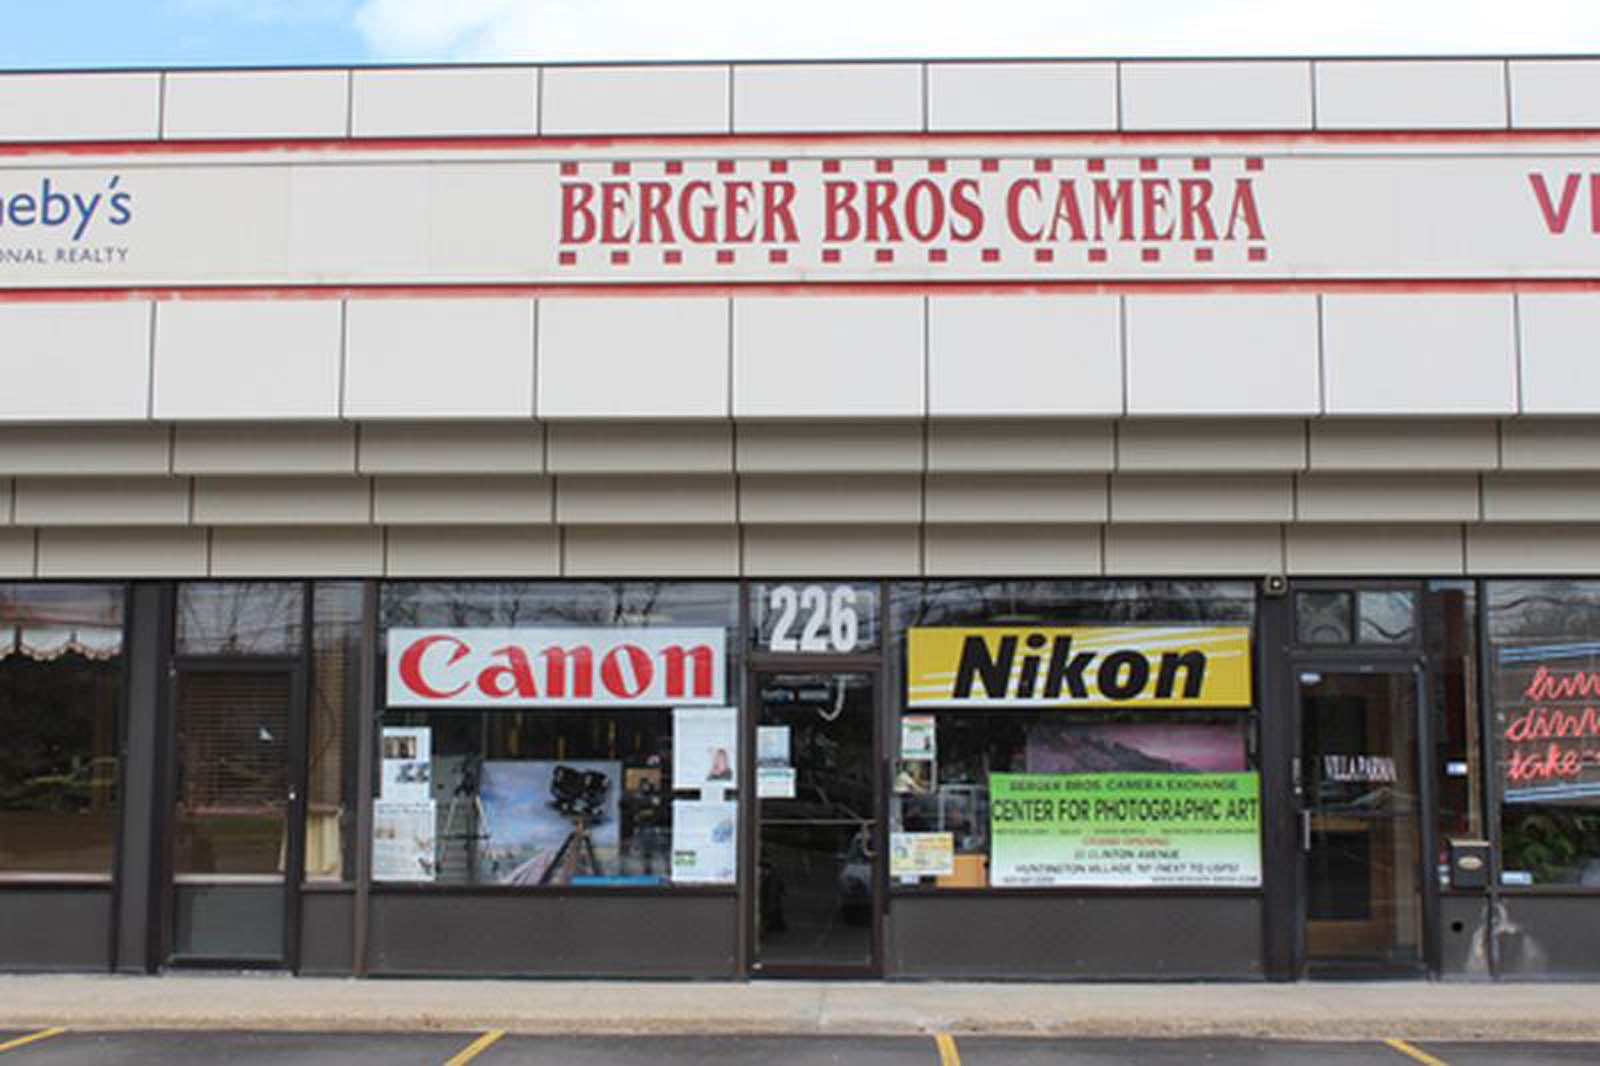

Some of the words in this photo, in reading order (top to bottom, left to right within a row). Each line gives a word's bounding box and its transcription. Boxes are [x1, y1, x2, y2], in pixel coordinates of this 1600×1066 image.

[0, 175, 131, 241] eby's
[560, 180, 799, 244] BERGER
[823, 178, 984, 243] BROS
[1006, 178, 1266, 242] CAMERA
[0, 248, 47, 263] NAL
[56, 247, 129, 263] REALTY
[770, 585, 859, 652] 226
[398, 634, 714, 699] Canon
[953, 633, 1207, 700] Nikon
[992, 799, 1055, 821] CENTER
[1059, 799, 1089, 821] FOR
[1095, 798, 1220, 821] PHOTOGRAPHIC
[1226, 798, 1258, 821] ART
